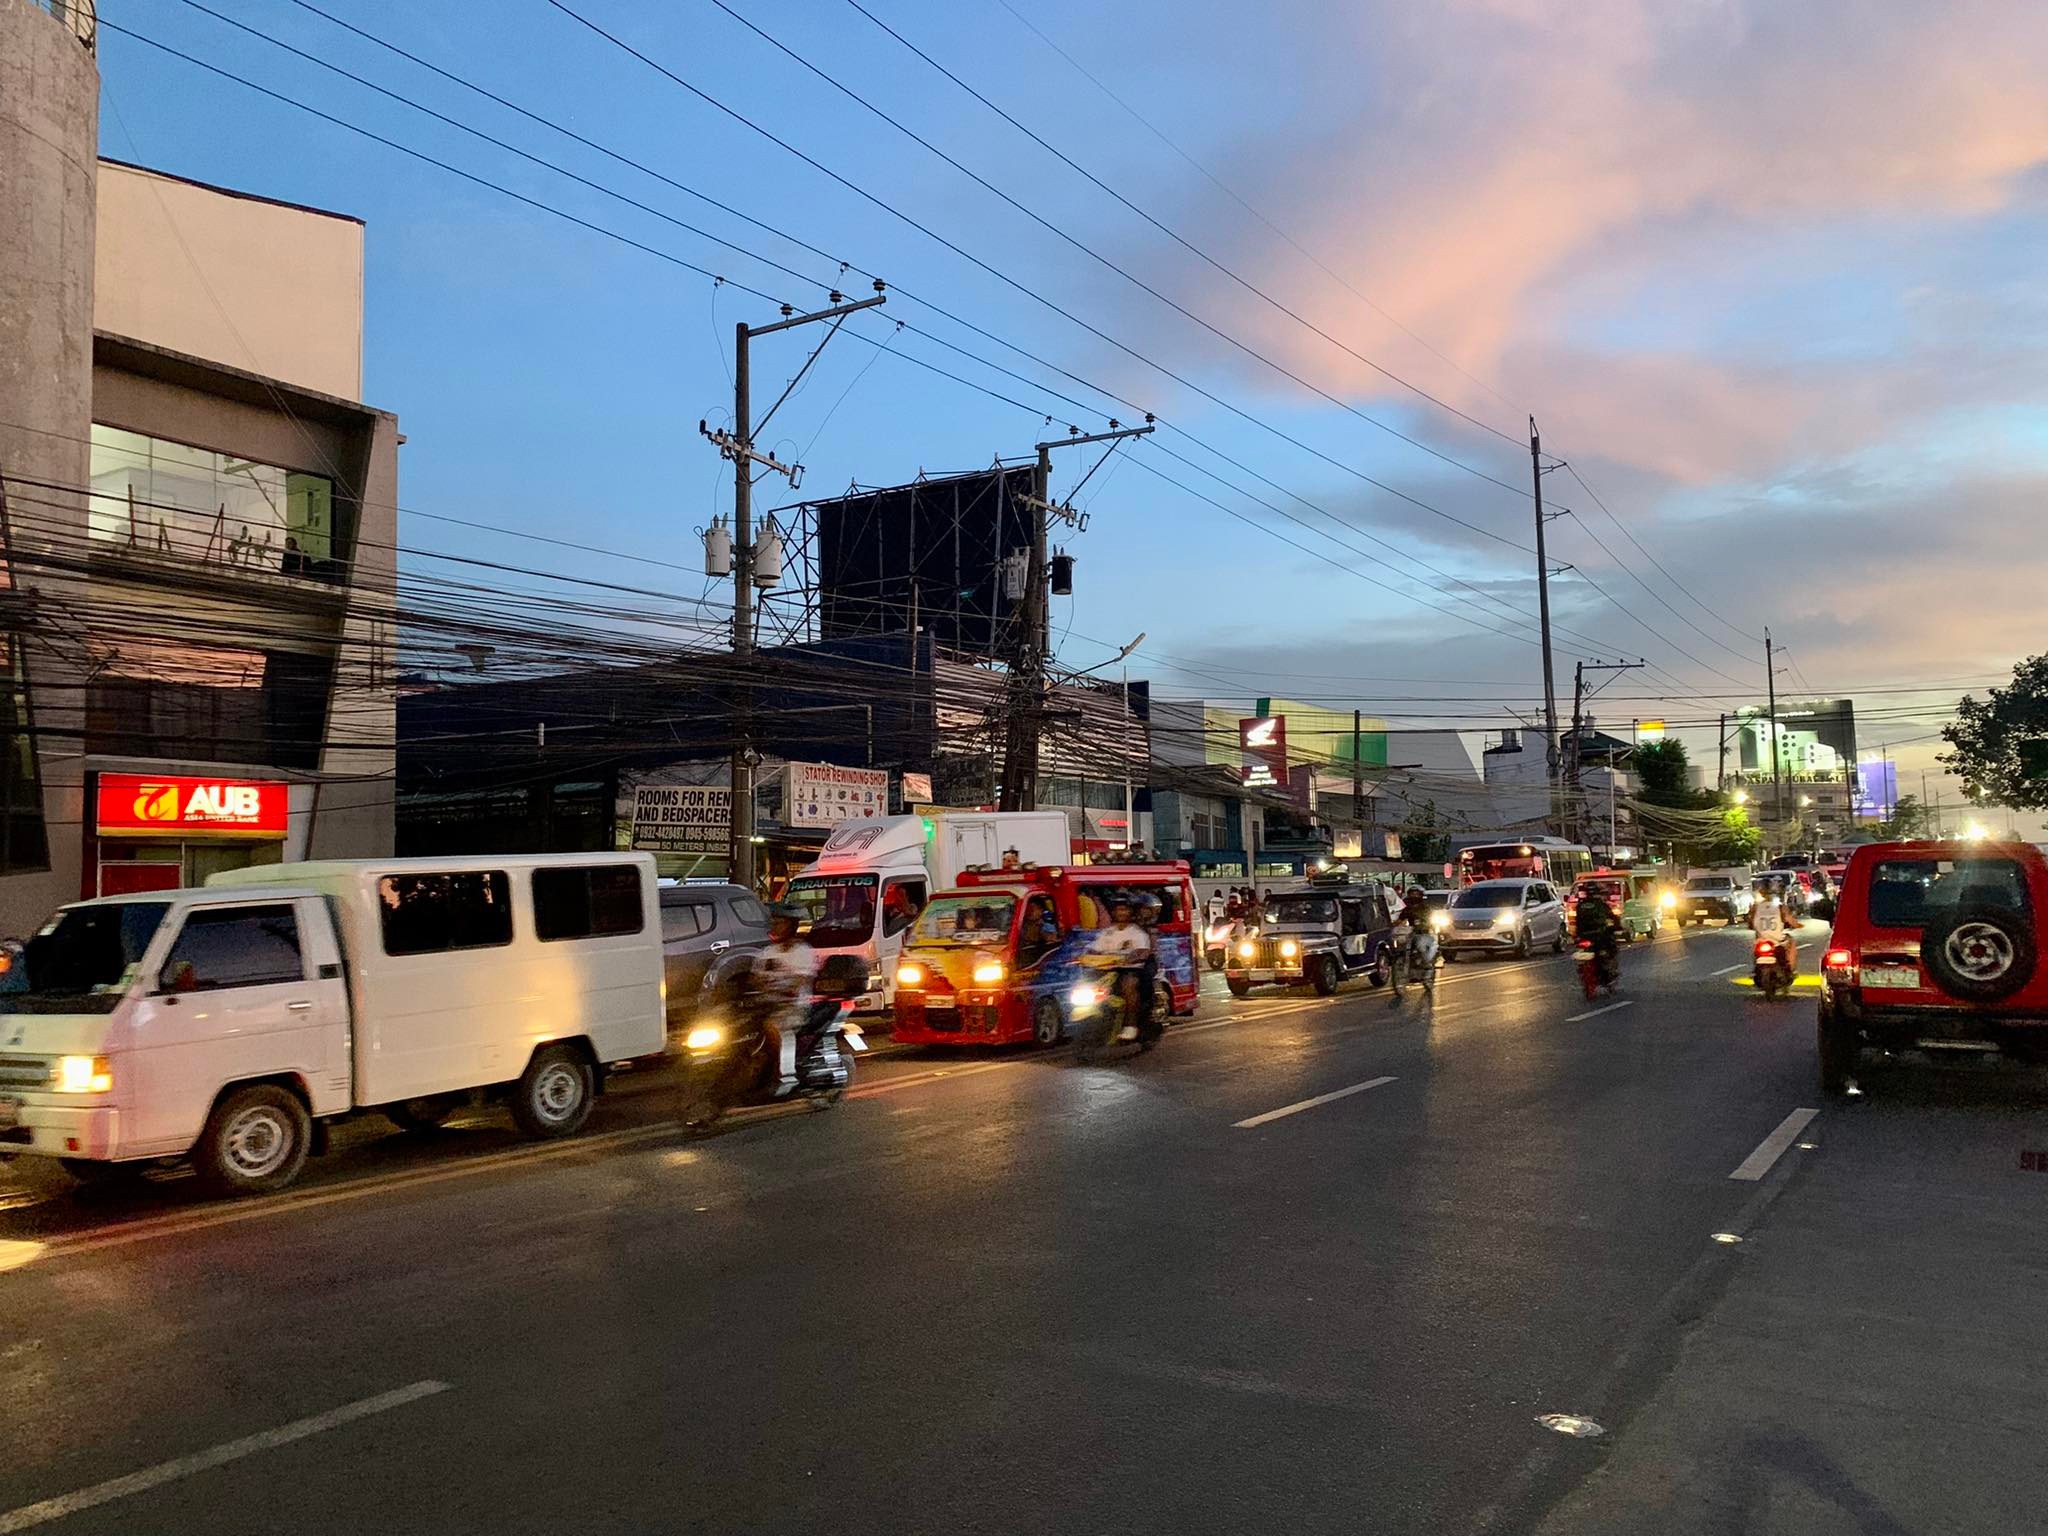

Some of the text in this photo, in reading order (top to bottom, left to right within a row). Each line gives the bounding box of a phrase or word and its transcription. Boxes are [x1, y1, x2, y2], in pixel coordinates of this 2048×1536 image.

[804, 766, 832, 781] STATOR
[832, 767, 869, 784] REWINDING
[869, 771, 887, 786] SHOP
[184, 784, 260, 816] AUB
[637, 790, 731, 806] ROOMS FOR REN
[635, 806, 659, 822] AND
[661, 841, 671, 850] 50
[672, 841, 705, 852] METERS
[790, 876, 874, 892] PARAKLETOS
